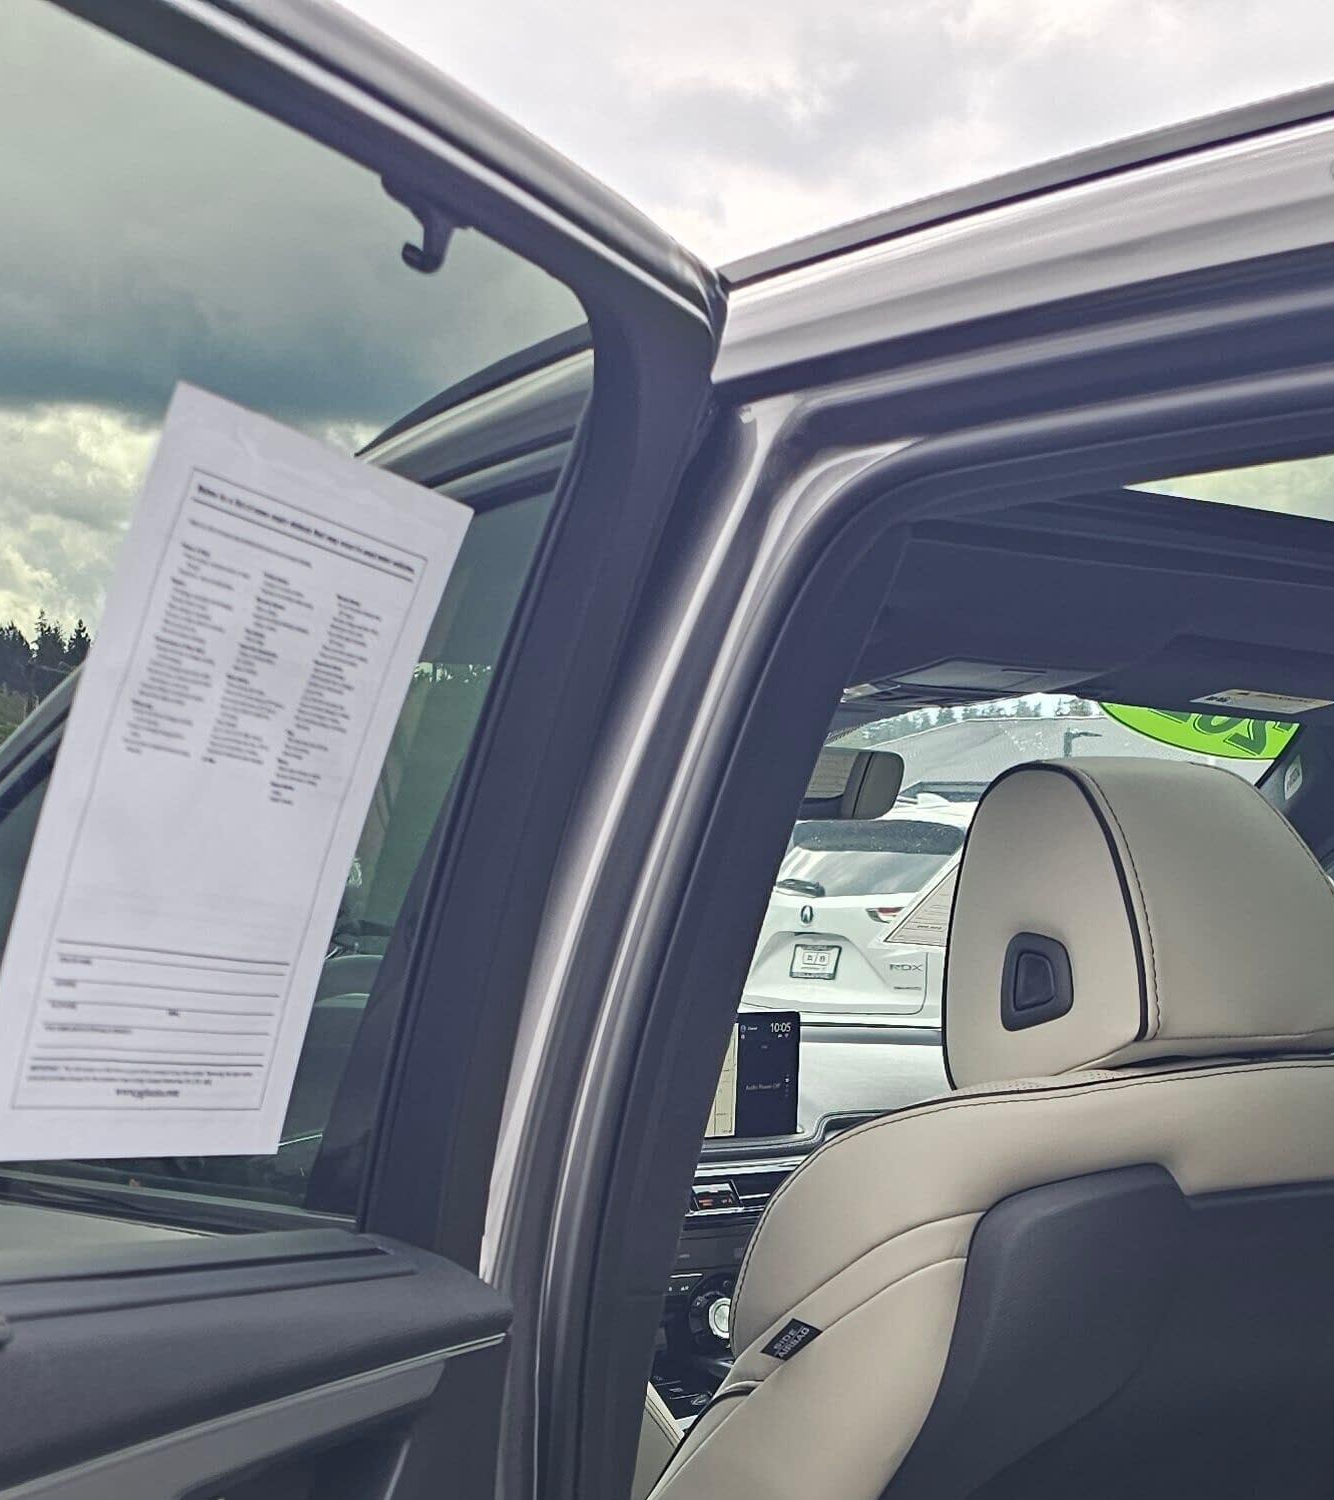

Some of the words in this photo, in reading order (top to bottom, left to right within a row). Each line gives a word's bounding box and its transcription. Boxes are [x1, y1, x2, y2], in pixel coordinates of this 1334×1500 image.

[889, 964, 923, 972] RDX
[769, 1022, 791, 1033] 10:05
[773, 1328, 796, 1349] SIDE
